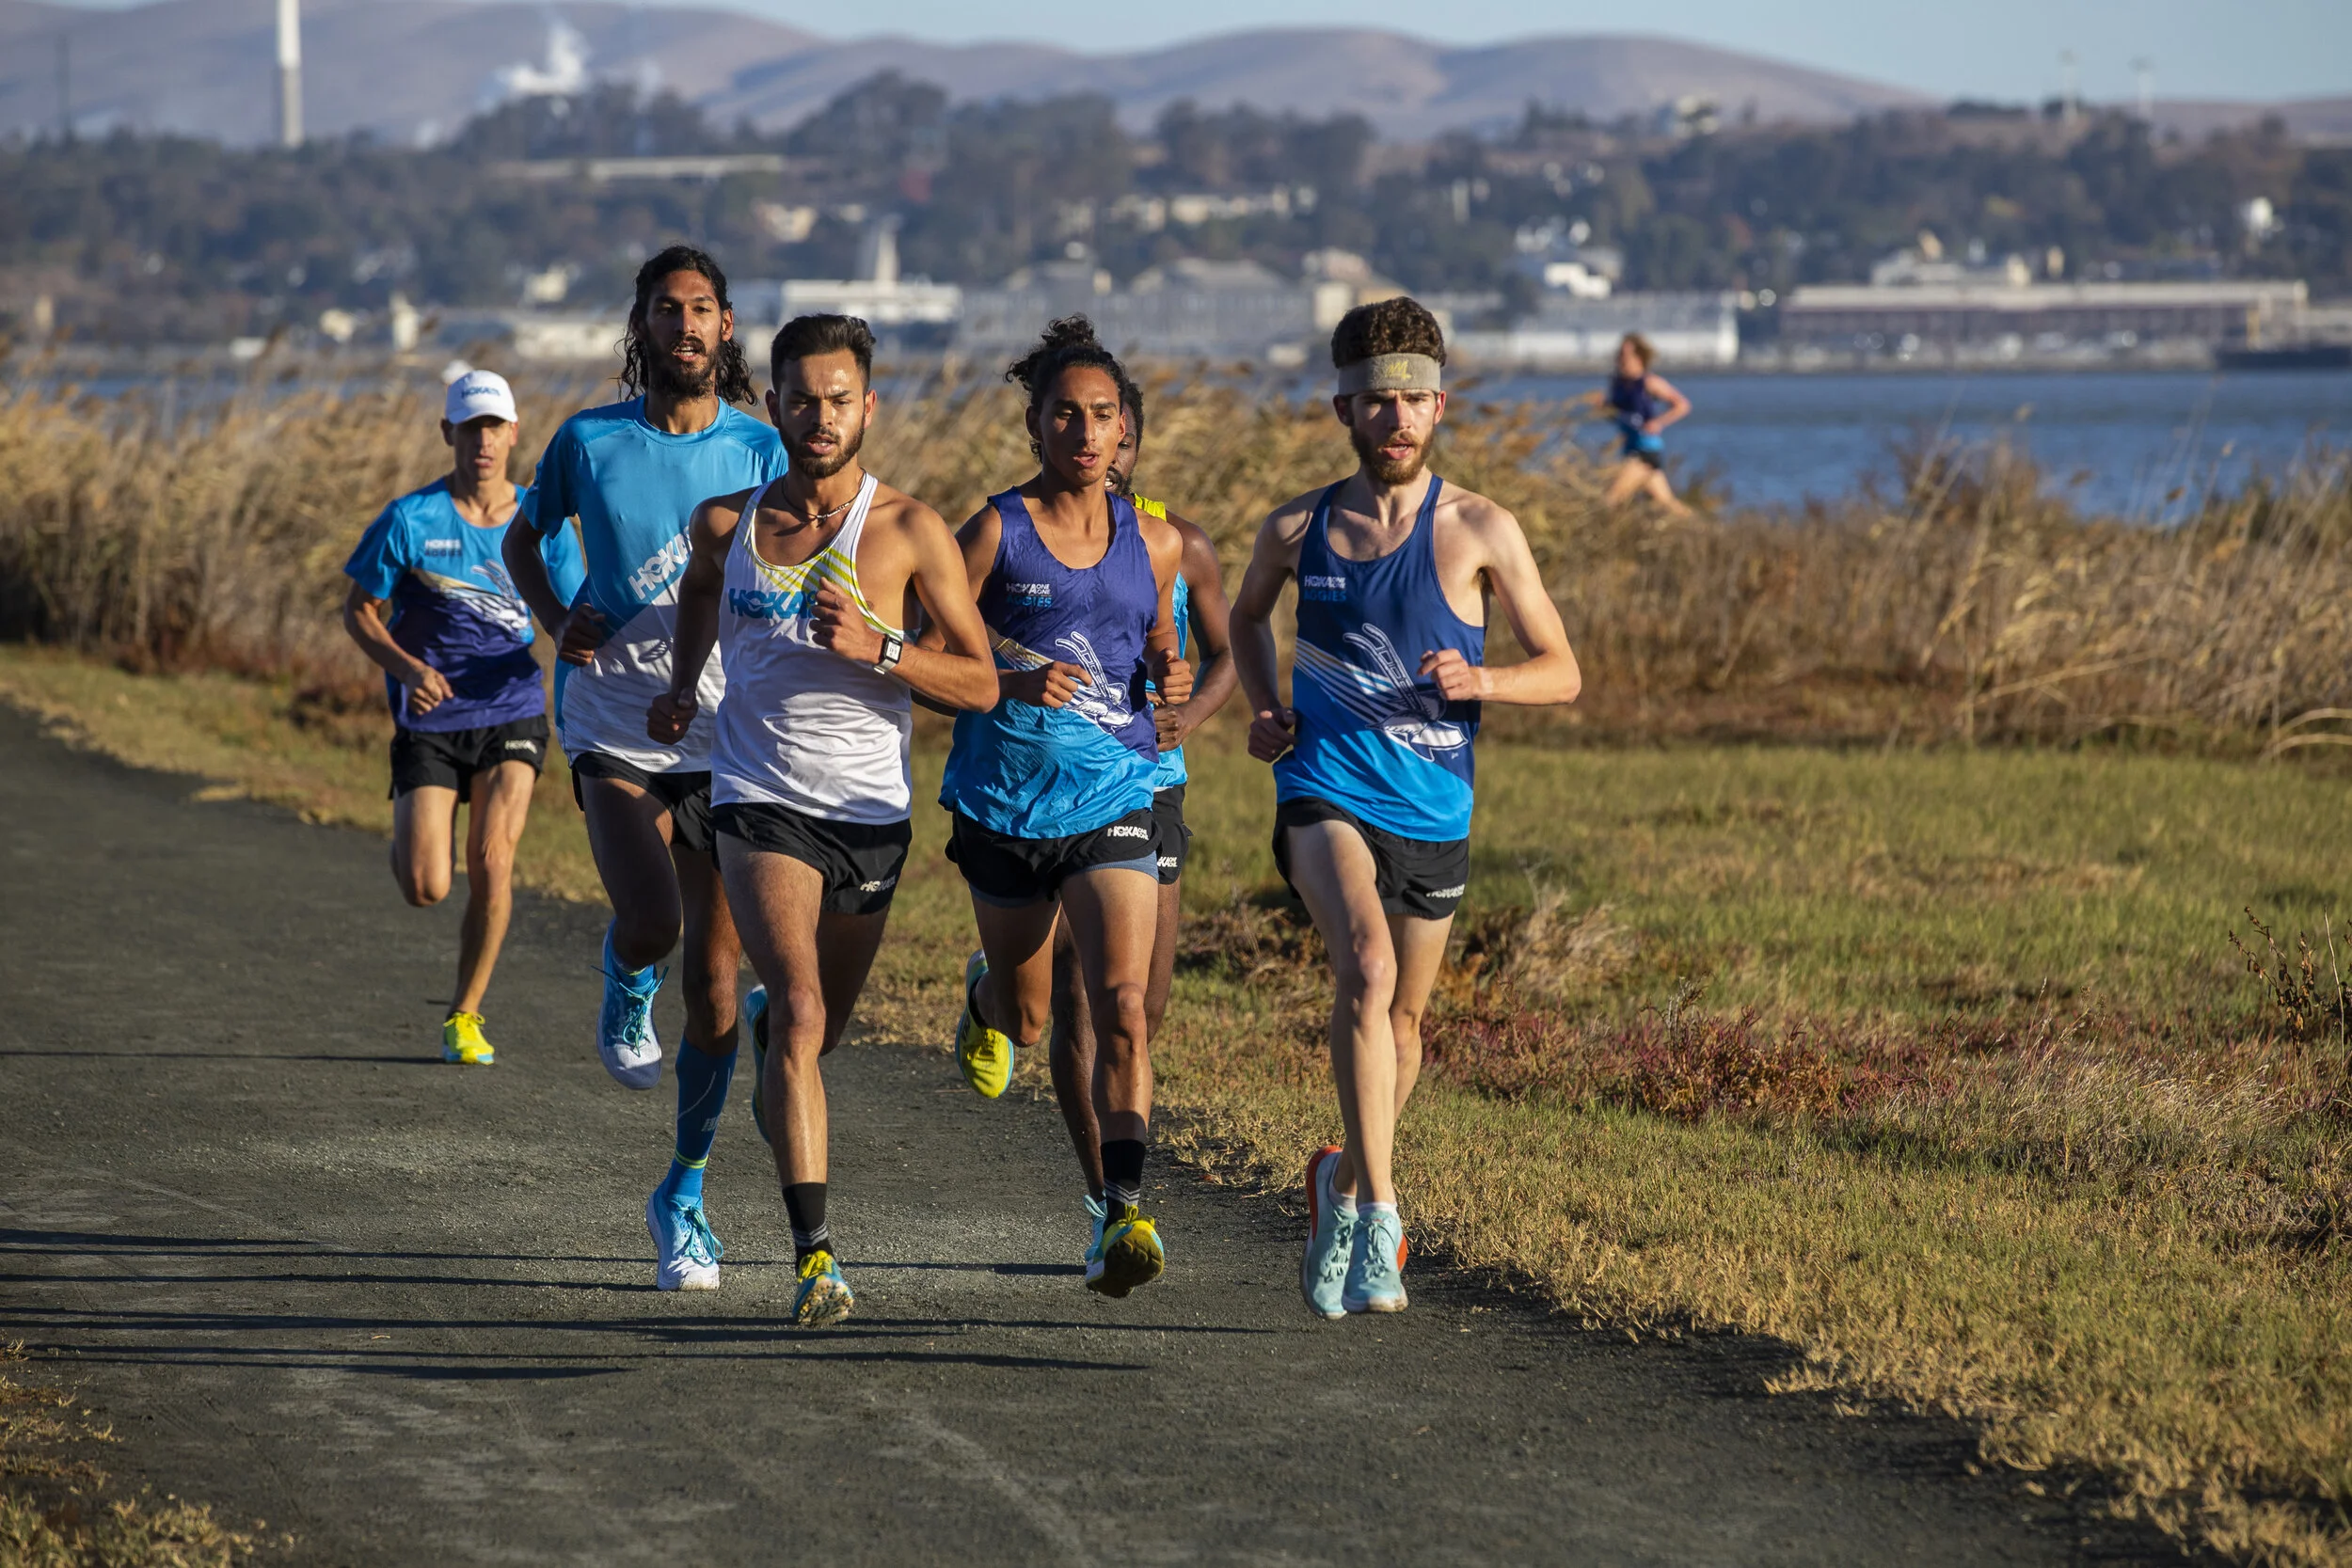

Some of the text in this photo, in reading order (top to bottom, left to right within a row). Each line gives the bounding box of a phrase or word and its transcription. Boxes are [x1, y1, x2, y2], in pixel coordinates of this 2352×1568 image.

[628, 532, 689, 600] HOKA
[1006, 582, 1037, 594] HOKA
[1304, 575, 1333, 588] HOKA
[1007, 594, 1053, 609] AGGIES
[1304, 589, 1347, 602] AGGIES
[728, 588, 808, 620] HOKA
[1107, 826, 1140, 837] HOKA
